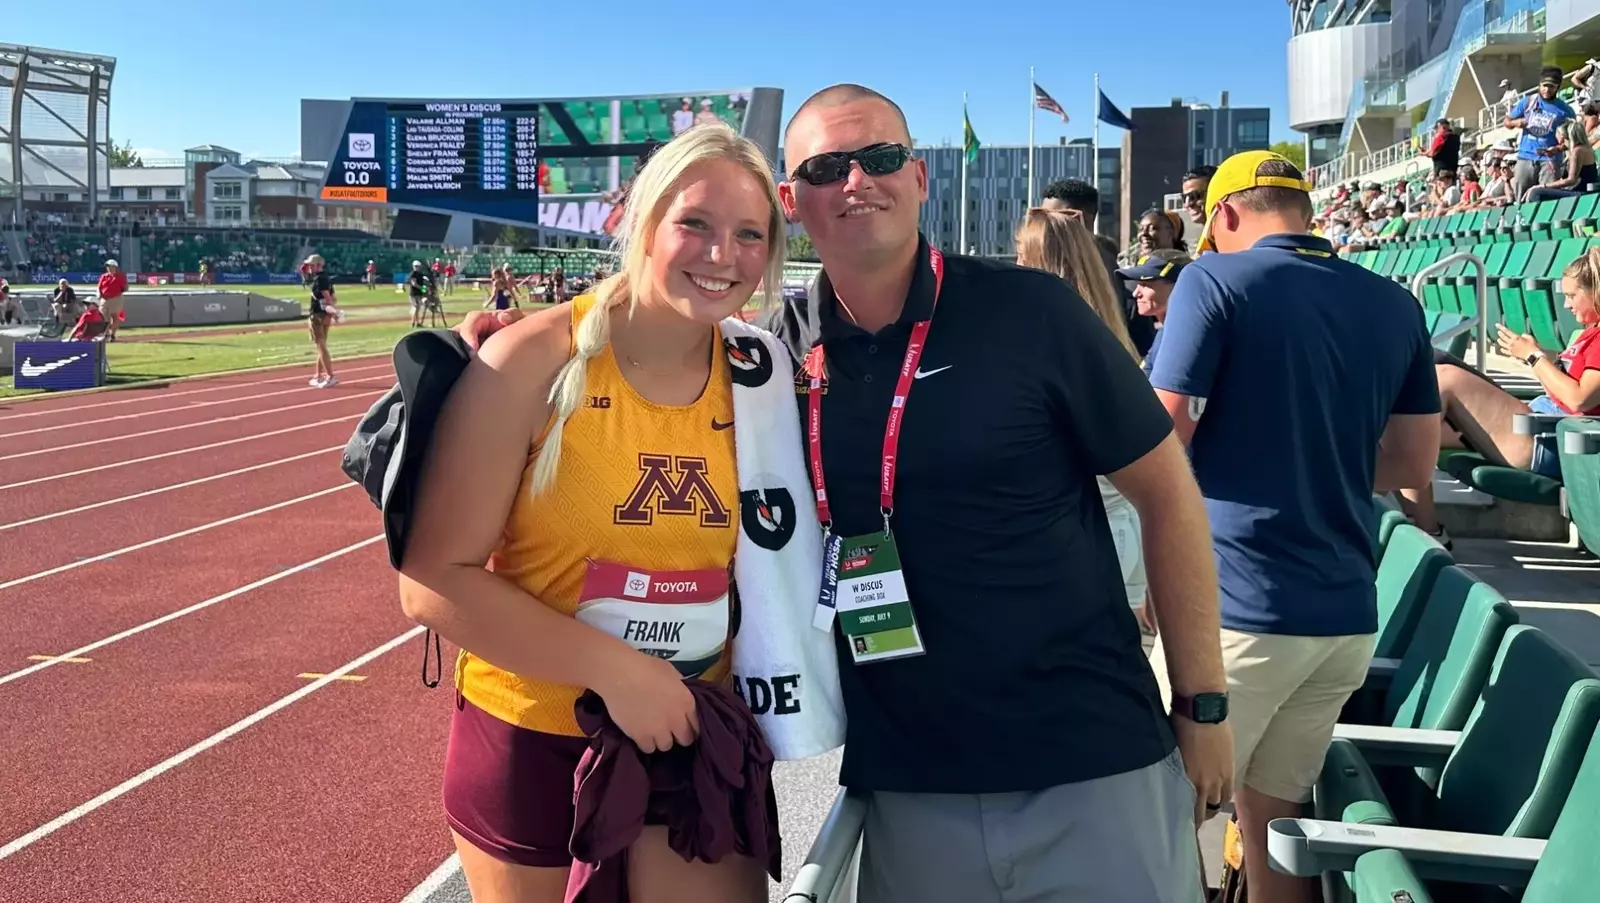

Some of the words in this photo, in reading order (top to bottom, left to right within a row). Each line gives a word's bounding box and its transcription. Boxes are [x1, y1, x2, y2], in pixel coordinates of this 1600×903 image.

[425, 103, 468, 112] WOMEN'S
[469, 103, 502, 112] DISCUS
[435, 117, 465, 125] ALLMAN
[439, 142, 466, 150] FRALEY
[433, 150, 459, 158] FRANK
[343, 161, 381, 170] TOYOTA
[345, 171, 370, 185] 0.0
[429, 174, 453, 182] SMITH
[434, 182, 461, 190] ULRICH
[888, 409, 899, 437] TOYOTA
[613, 453, 731, 527] M
[829, 569, 837, 587] VIP
[653, 581, 698, 593] TOYOTA
[852, 584, 859, 593] W
[860, 580, 884, 592] DISCUS
[855, 593, 876, 603] COACHING
[887, 611, 891, 620] 9
[623, 619, 686, 643] FRANK
